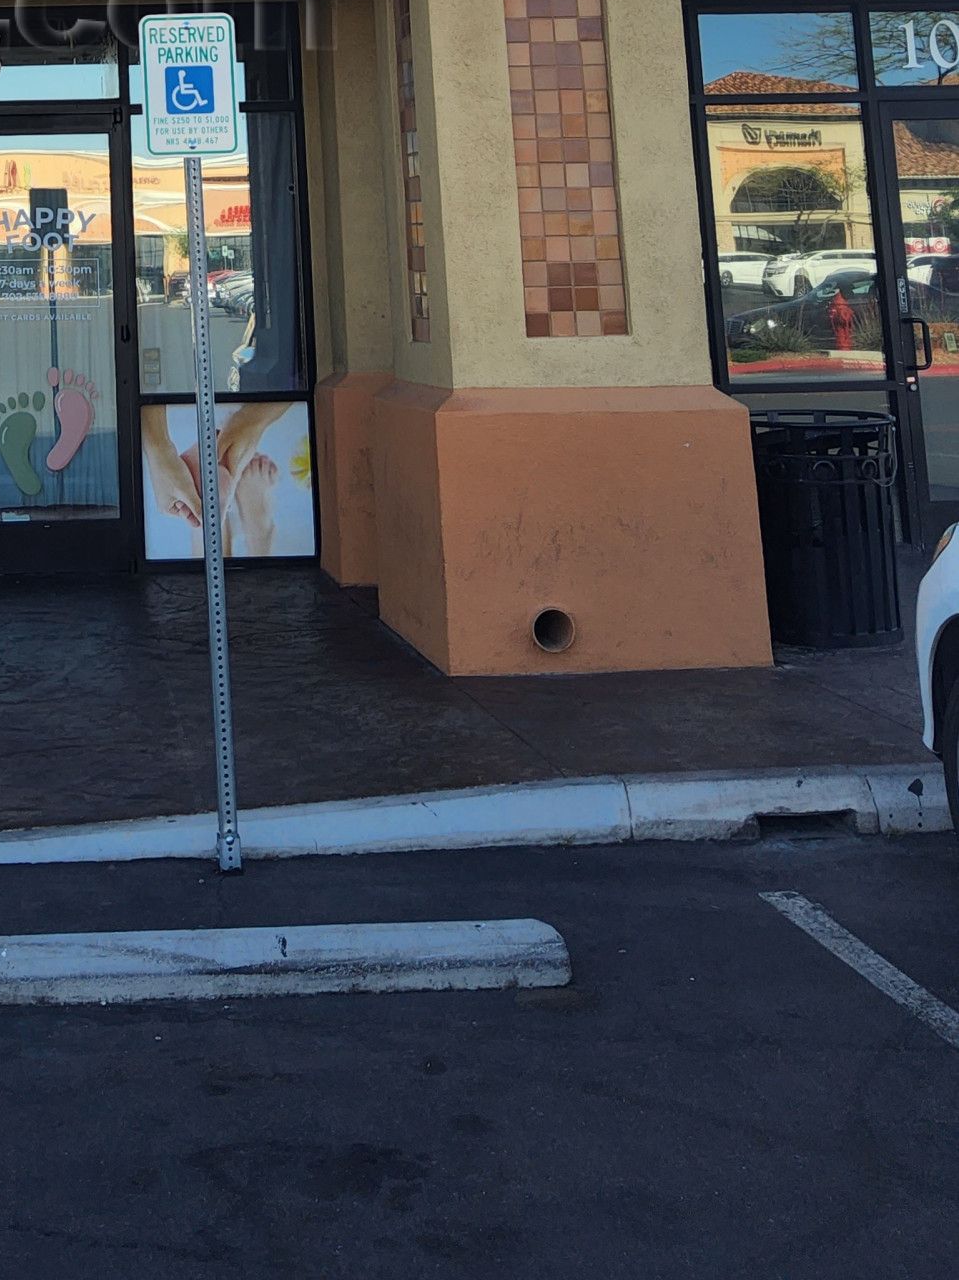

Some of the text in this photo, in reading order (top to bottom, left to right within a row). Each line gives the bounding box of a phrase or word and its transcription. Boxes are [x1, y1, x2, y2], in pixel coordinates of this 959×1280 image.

[149, 26, 225, 44] RESERVED
[157, 46, 219, 64] PARKING
[153, 117, 168, 125] FINE
[172, 116, 190, 125] $250
[193, 116, 203, 124] TO
[155, 126, 229, 135] FOR USE BY OTHERS
[6, 232, 79, 254] FOOT
[9, 279, 36, 291] days
